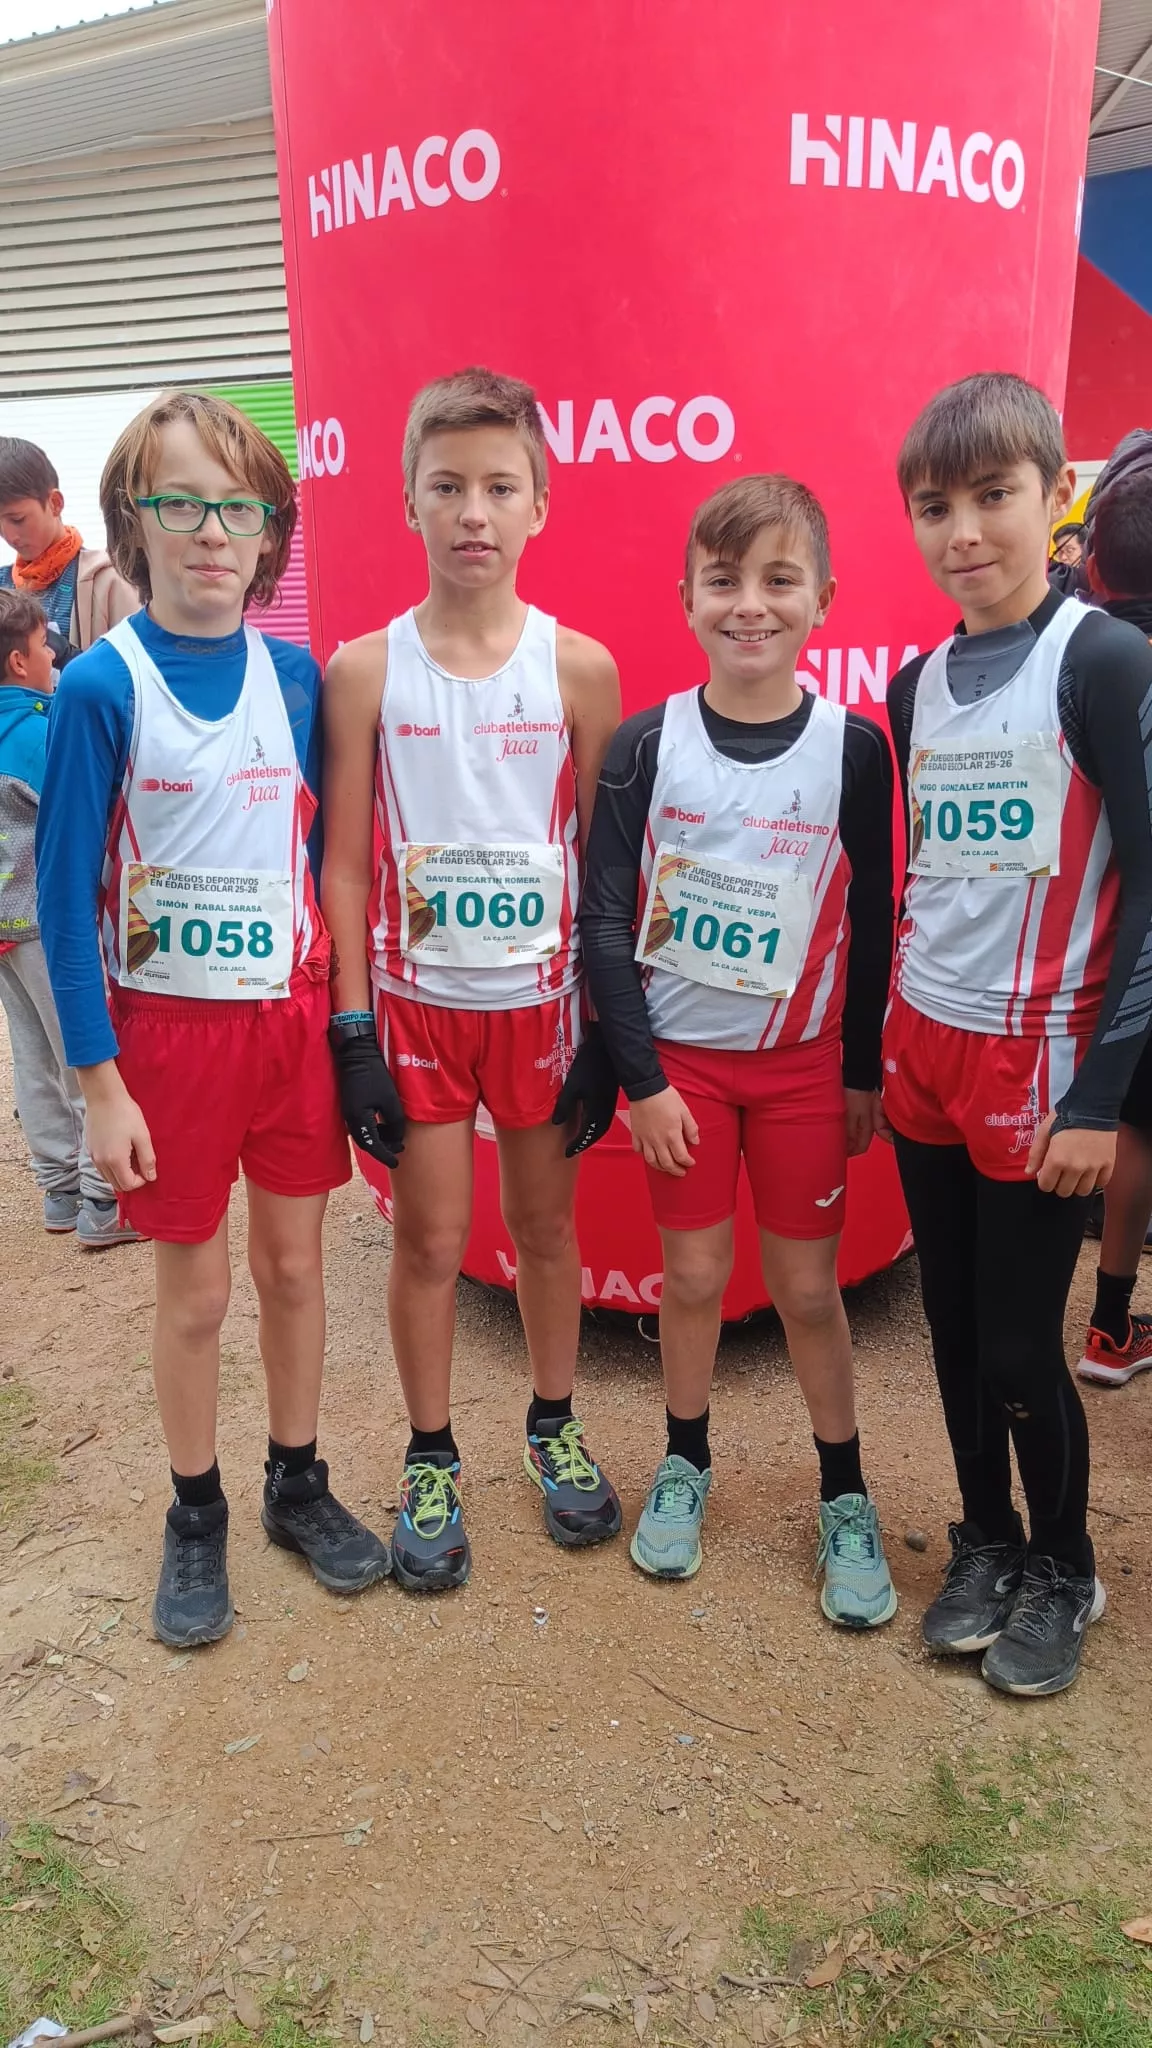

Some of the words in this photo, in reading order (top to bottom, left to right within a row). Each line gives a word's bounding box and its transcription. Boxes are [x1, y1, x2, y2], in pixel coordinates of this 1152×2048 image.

[789, 113, 1025, 210] HINACO
[308, 128, 501, 238] HINACO
[536, 395, 736, 463] NACO
[973, 673, 987, 697] KIP
[414, 724, 441, 736] barri
[473, 721, 560, 735] clubatletismo
[496, 734, 539, 761] jaca
[930, 753, 954, 762] JUEGOS
[955, 750, 1014, 762] DEPORTIVOS
[928, 763, 947, 771] EDAD
[948, 761, 983, 771] ESCOLAR
[984, 760, 1013, 769] 25-26
[162, 779, 193, 792] barri
[941, 782, 985, 792] GONZALEZ
[987, 780, 1028, 790] MARTIN
[242, 780, 280, 811] jaca
[677, 810, 706, 824] barri
[742, 815, 830, 836] clubatletismo
[921, 798, 1034, 842] 1059
[441, 849, 475, 858] JUEGOS
[476, 850, 530, 859] DEPORTIVOS
[760, 832, 809, 860] jaca
[426, 856, 438, 864] EN
[440, 857, 463, 865] EDAD
[465, 857, 504, 866] ESCOLAR
[506, 858, 529, 866] 25-26
[150, 878, 163, 887] EN
[165, 881, 191, 891] EDAD
[193, 883, 234, 893] ESCOLAR
[235, 885, 258, 894] 25-26
[166, 872, 204, 883] JUEGOS
[205, 875, 259, 886] DEPORTIVOS
[425, 875, 454, 883] DAVID
[456, 876, 502, 884] ESCARTIN
[676, 870, 687, 879] EN
[688, 874, 710, 886] EDAD
[711, 879, 750, 895] ESCOLAR
[752, 888, 777, 900] 25-26
[691, 866, 722, 881] JUEGOS
[723, 875, 779, 892] DEPORTIVOS
[194, 903, 227, 912] RABAL
[228, 904, 263, 913] SARASA
[427, 890, 545, 928] 1060
[679, 889, 709, 904] MATEO
[747, 907, 777, 919] VESPA
[149, 915, 273, 959] 1058
[669, 905, 781, 964] 1061
[731, 966, 748, 974] JACA
[412, 1054, 438, 1071] barri
[985, 1112, 1044, 1126] clubatlet
[1008, 1126, 1036, 1154] ja
